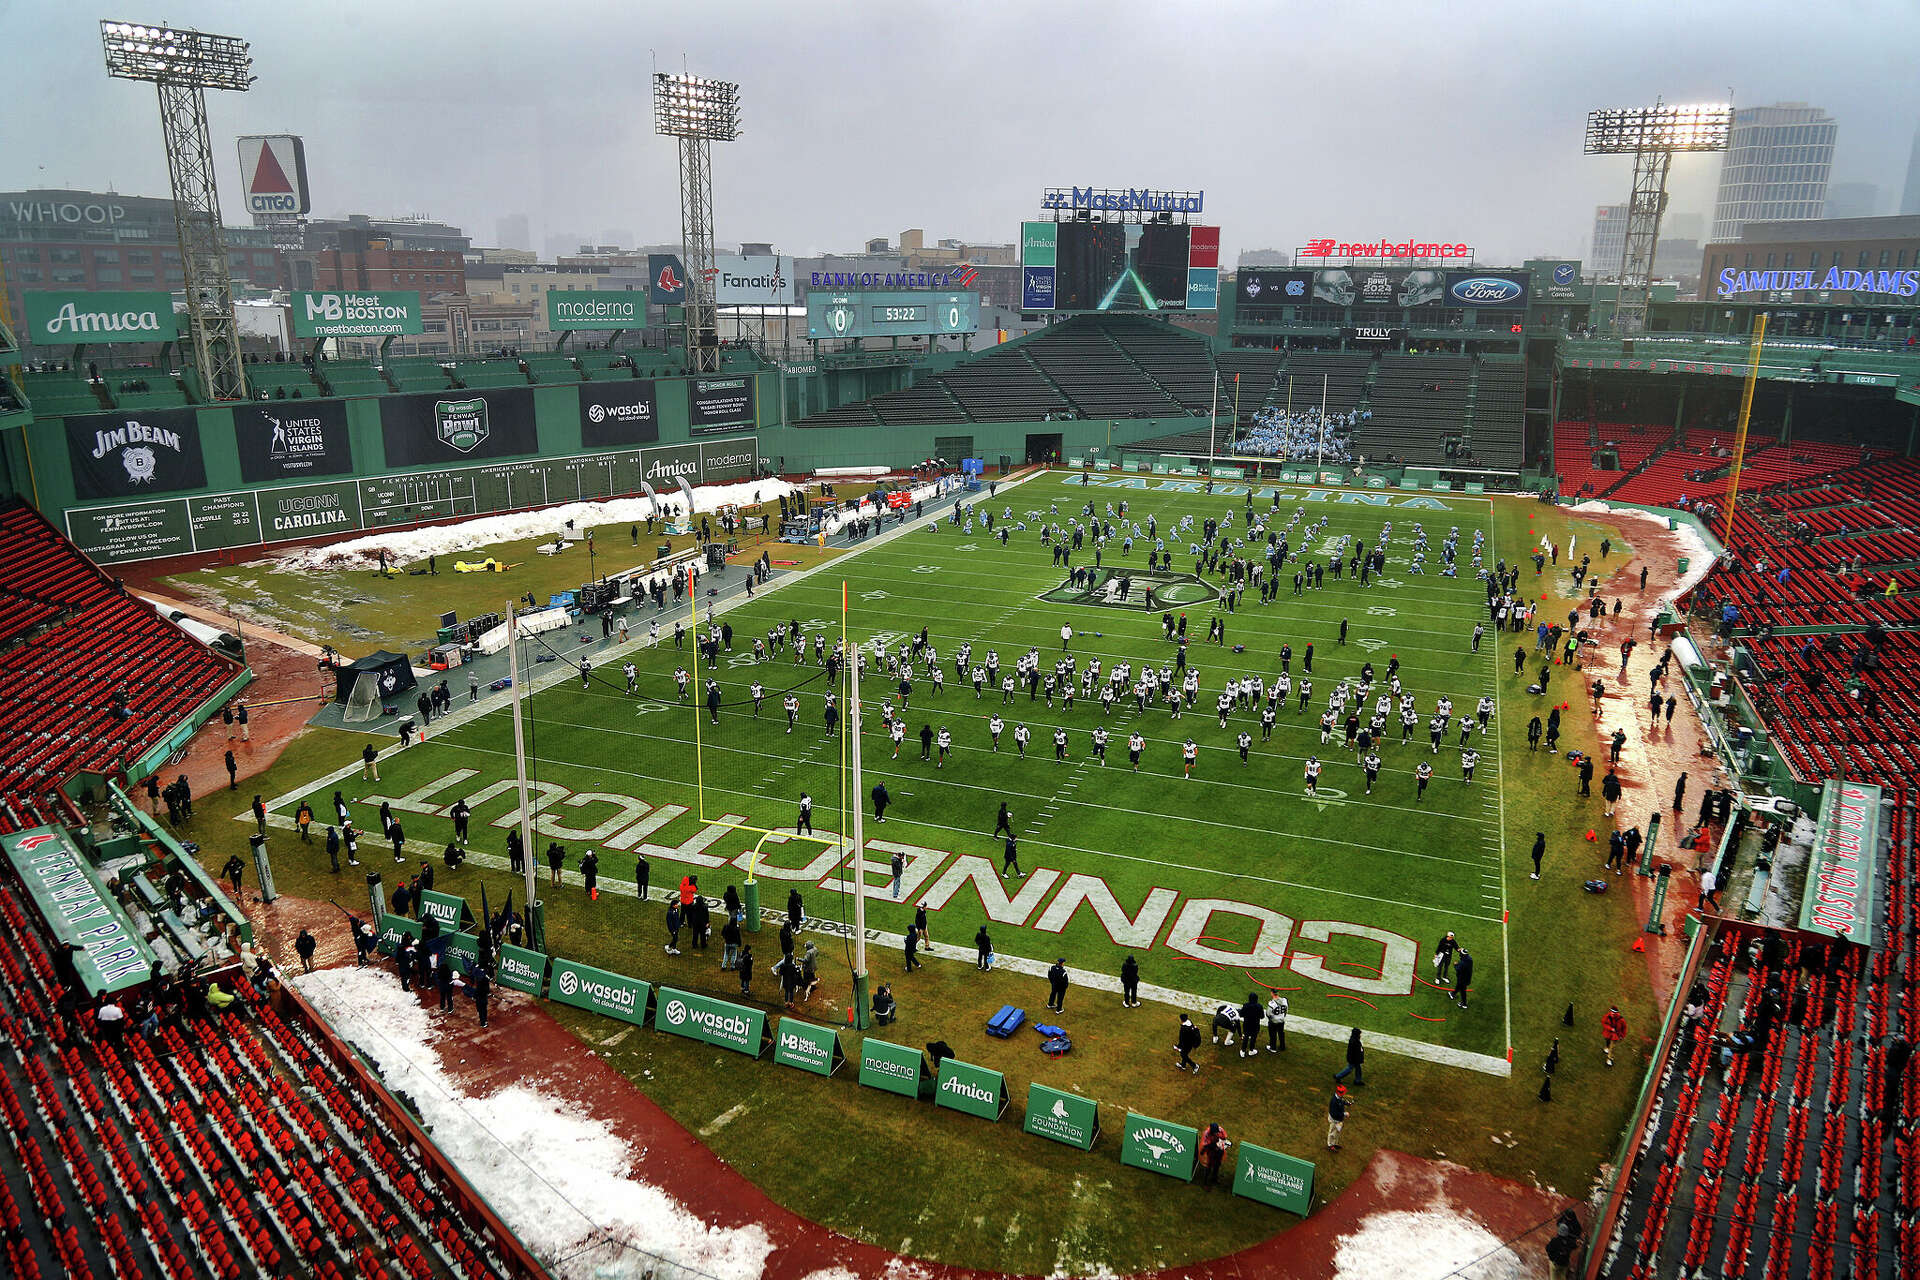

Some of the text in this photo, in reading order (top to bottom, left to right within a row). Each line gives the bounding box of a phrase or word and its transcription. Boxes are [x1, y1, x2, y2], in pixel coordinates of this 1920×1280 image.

[251, 194, 296, 211] CITGO
[1072, 186, 1204, 213] MassMutual
[11, 201, 125, 225] WHOOP
[723, 273, 786, 288] Fanatics
[811, 272, 951, 287] BANK OF AMERICA
[1717, 265, 1920, 297] SAMUEL ADAMS
[1465, 280, 1507, 299] Ford
[345, 294, 380, 307] Meet
[557, 299, 634, 317] moderna
[46, 302, 160, 334] Amica
[346, 306, 408, 320] BOSTON
[835, 310, 846, 331] 0
[886, 308, 915, 321] 53:22
[949, 307, 959, 328] 0
[315, 324, 403, 335] meetboston.com
[1356, 328, 1391, 337] TRULY
[787, 366, 817, 375] ABIOMED
[448, 412, 476, 420] FENWAY
[606, 401, 650, 417] wasabi
[285, 418, 321, 428] UNITED
[443, 418, 485, 439] BOWL
[287, 426, 322, 437] STATES
[92, 421, 181, 459] JIM BEAM
[287, 435, 323, 445] VIRGIN
[289, 443, 324, 452] ISLANDS
[136, 457, 144, 467] B
[646, 457, 697, 478] Amica
[706, 453, 752, 467] moderna
[481, 465, 510, 474] AMERICAN
[382, 472, 451, 484] FENWAY PARK
[1062, 474, 1455, 512] CAROLINA
[202, 501, 245, 512] CHAMPIONS
[279, 494, 339, 513] UCONN
[125, 508, 166, 518] INFORMATION
[128, 517, 140, 525] US
[192, 514, 222, 523] LOUISVILLE
[274, 509, 347, 530] CAROLINA
[100, 520, 163, 533] FENWAYBOWL.COM
[109, 534, 137, 543] FOLLOW
[146, 536, 181, 545] FACEBOOK
[109, 545, 162, 557] @FENWAYBOWL
[1810, 799, 1870, 935] BOSTON RED SOX
[354, 767, 1419, 997] CONNECTICUT
[30, 850, 151, 985] FENWAY PARK
[423, 901, 457, 920] TRULY
[516, 960, 530, 971] Meet
[516, 967, 540, 980] BOSTON
[502, 974, 536, 988] meetboston.com
[581, 979, 637, 1007] wasabi
[592, 996, 634, 1015] hot cloud storage
[689, 1008, 752, 1036] wasabi
[703, 1025, 749, 1045] hot cloud storage
[800, 1037, 817, 1047] Meet
[799, 1043, 829, 1058] BOSTON
[782, 1051, 824, 1067] meetboston.com
[865, 1056, 914, 1077] moderna
[942, 1076, 995, 1104] Amica
[1031, 1117, 1083, 1139] FOUNDATION
[1132, 1127, 1186, 1154] KINDER'S
[1257, 1165, 1304, 1186] UNITED STATES
[1257, 1171, 1278, 1183] VIRGIN
[1278, 1178, 1303, 1191] ISLANDS
